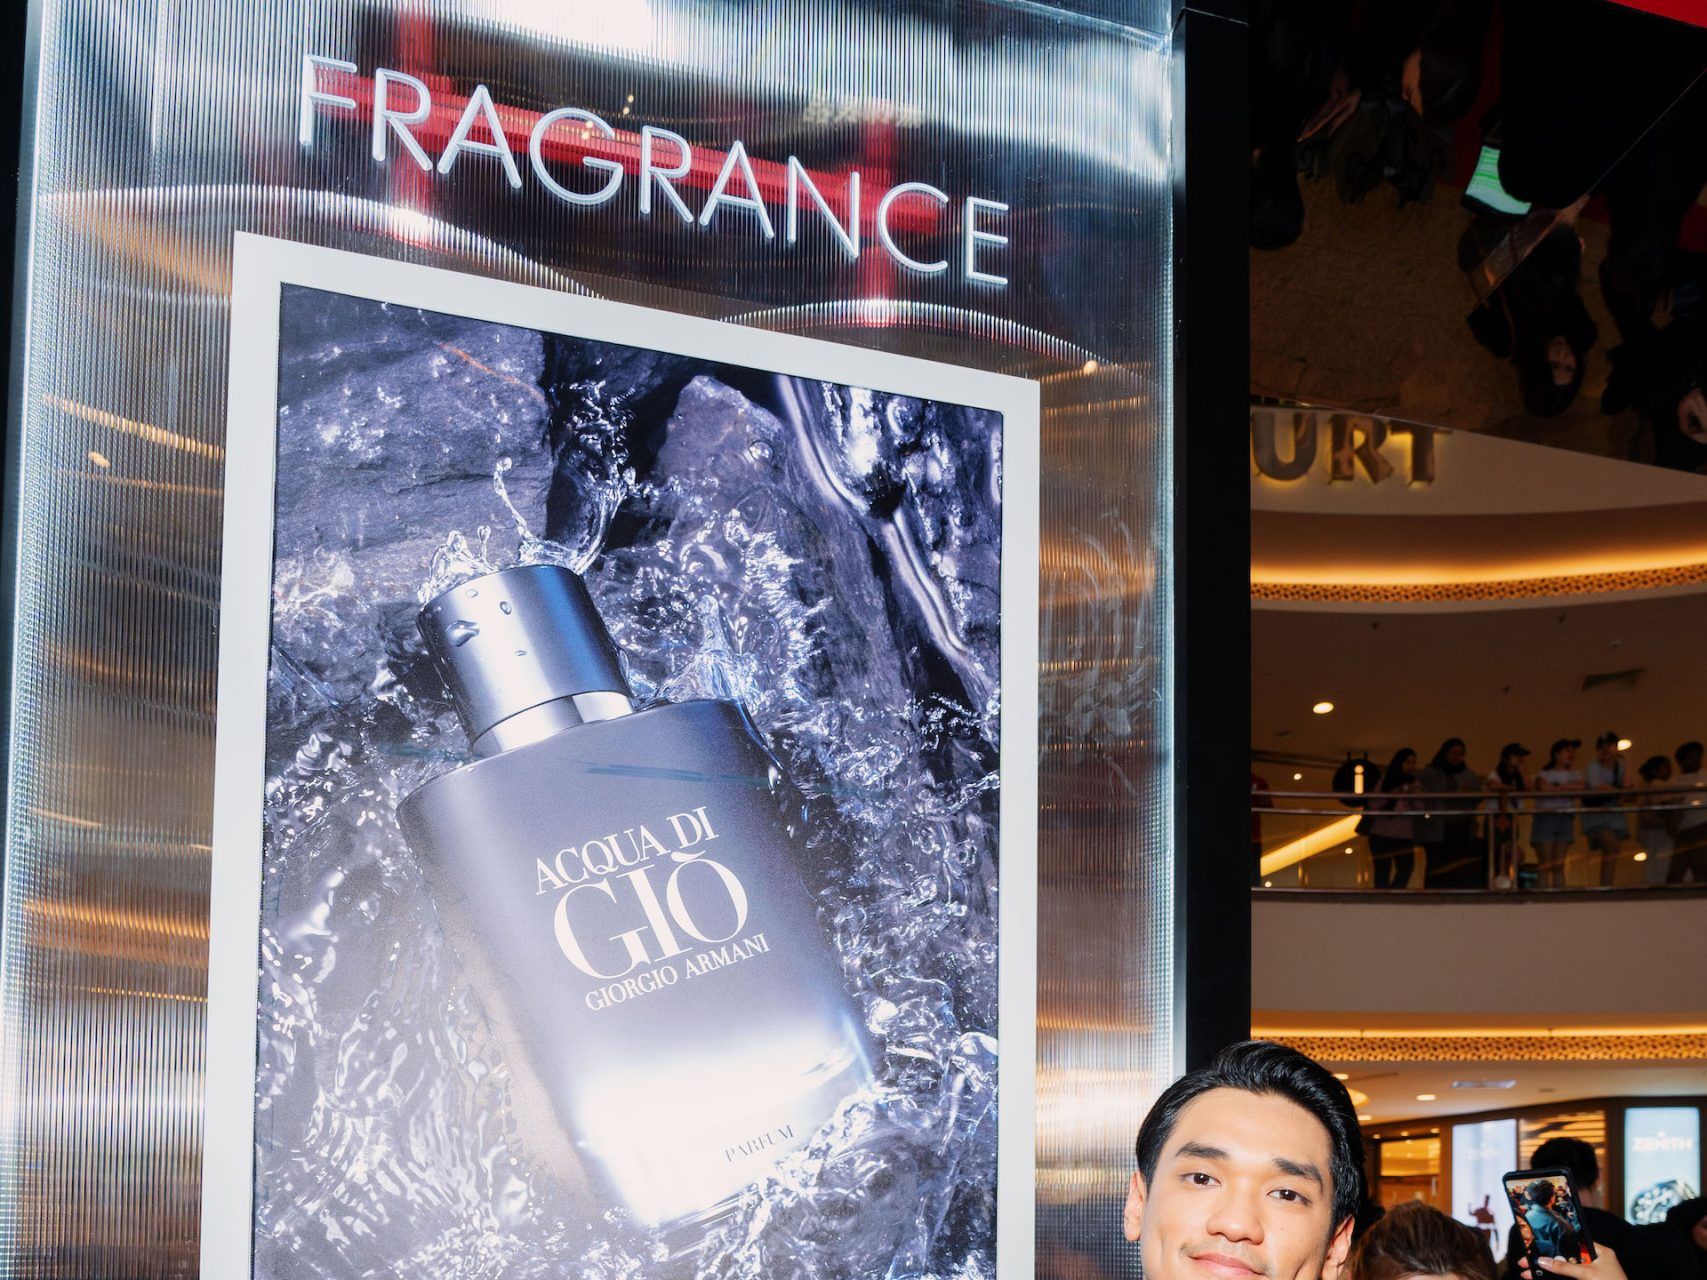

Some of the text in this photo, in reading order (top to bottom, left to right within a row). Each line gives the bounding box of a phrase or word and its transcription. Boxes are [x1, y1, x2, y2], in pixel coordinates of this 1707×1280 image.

[298, 54, 1009, 286] FRAGRANCE
[535, 806, 719, 895] ACQUA DI
[585, 933, 771, 1012] GIORGIO ARMANI
[723, 1124, 795, 1163] PARFUM
